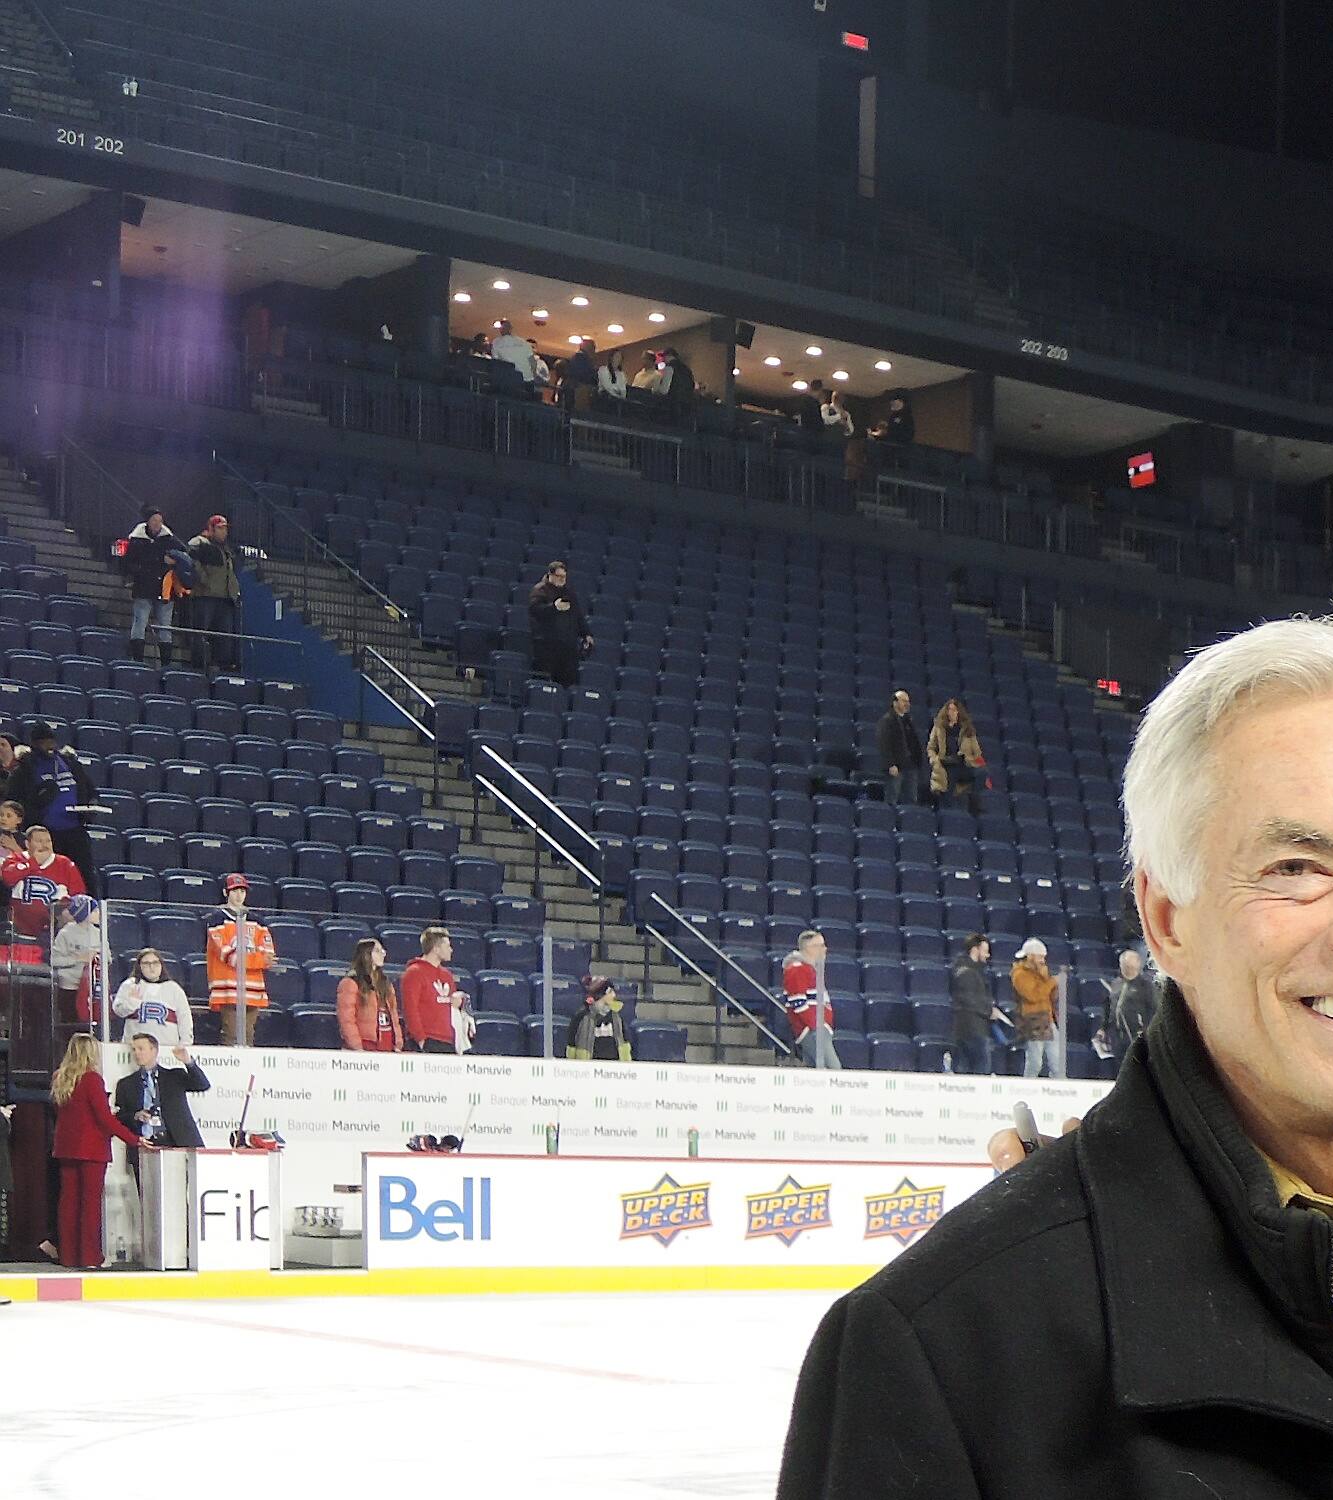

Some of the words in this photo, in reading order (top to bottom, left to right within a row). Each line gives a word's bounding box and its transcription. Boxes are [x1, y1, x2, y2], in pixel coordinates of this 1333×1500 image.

[57, 128, 84, 147] 201
[94, 136, 124, 155] 202
[287, 1058, 327, 1071] Banque
[332, 1059, 380, 1072] Manuvie
[424, 1062, 462, 1075] Banque
[467, 1064, 512, 1076] Manuvie
[594, 1068, 637, 1081] Manuvie
[715, 1073, 756, 1085] Manuvie
[830, 1078, 868, 1089] Manuvie
[216, 1088, 257, 1100] Banqe
[263, 1088, 312, 1100] Manuvie
[357, 1090, 396, 1104] Banque
[401, 1091, 447, 1104] Manuvie
[490, 1094, 528, 1107] Banque
[532, 1095, 576, 1107] Manuvie
[655, 1099, 698, 1111] Manuvie
[774, 1103, 814, 1115] Manuvie
[198, 1118, 240, 1130] anuvie
[287, 1119, 327, 1132] Banque
[332, 1120, 380, 1132] Manuvie
[424, 1121, 462, 1134] Banque
[468, 1123, 512, 1135] Manuvie
[594, 1126, 638, 1138] Manuvie
[715, 1129, 756, 1141] Manuvie
[830, 1132, 868, 1143] Manuvie
[379, 1175, 491, 1241] Bell
[625, 1191, 706, 1215] UPPER
[751, 1191, 827, 1214] UPPER
[868, 1193, 941, 1215] UPPER
